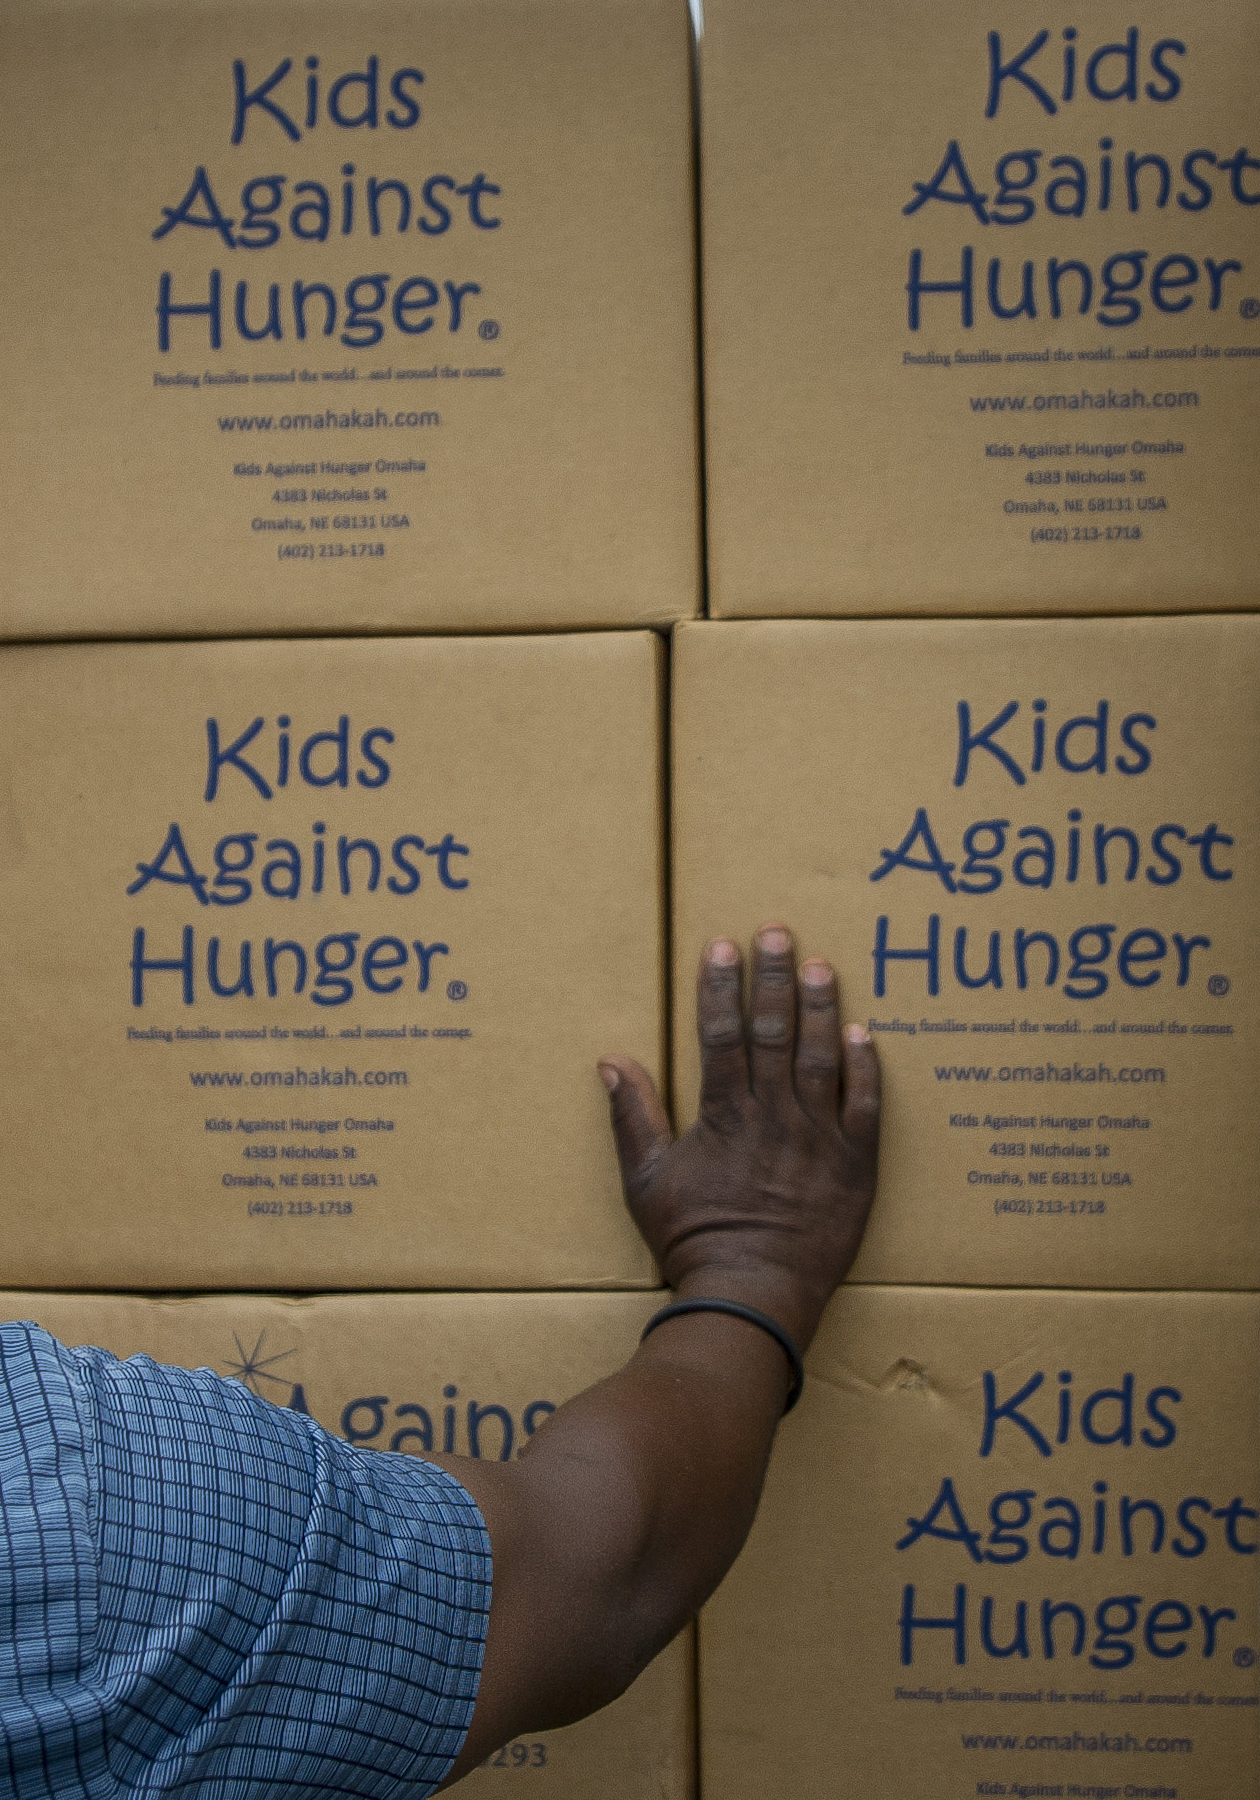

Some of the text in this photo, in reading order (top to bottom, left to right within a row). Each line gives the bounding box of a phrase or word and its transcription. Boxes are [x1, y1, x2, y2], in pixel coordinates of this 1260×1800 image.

[985, 25, 1187, 118] Kids
[231, 55, 425, 146] Kids
[902, 137, 1260, 226] Against
[151, 163, 501, 250] Against
[1053, 348, 1074, 362] the
[1201, 344, 1221, 358] the
[298, 369, 318, 383] the
[440, 366, 460, 379] the
[969, 388, 1200, 412] www.omahakah.com
[218, 408, 440, 432] www.omahakah.com
[985, 440, 1184, 459] Kids Against Hunger Omaha
[233, 459, 426, 477] Kids Against Hunger Omaha
[1025, 469, 1145, 485] 4383 Nicholas St
[272, 487, 387, 503] 4383 Nicholas St
[1003, 496, 1167, 514] Omaha, NE 68131 USA
[251, 514, 410, 532] Omaha, NE 68131 USA
[1031, 526, 1142, 543] (402) 213-1718
[278, 543, 385, 561] (402) 213-1718
[953, 698, 1157, 788] Kids
[204, 713, 396, 803] Kids
[869, 806, 1234, 895] Against
[126, 821, 470, 906] Against
[270, 1026, 290, 1040] the
[410, 1025, 429, 1038] the
[1019, 1019, 1040, 1034] the
[1168, 1020, 1188, 1035] the
[190, 1067, 408, 1087] www.omahakah.com
[934, 1063, 1167, 1084] www.omahakah.com
[205, 1118, 394, 1133] Kids Against Hunger Omaha
[949, 1113, 1151, 1131] Kids Against Hunger Omaha
[242, 1145, 356, 1159] 4383 Nicholas St
[989, 1143, 1110, 1157] 4383 Nicholas St
[222, 1173, 378, 1188] Omaha, NE 68131 USA
[967, 1171, 1133, 1186] Omaha, NE 68131 USA
[248, 1201, 353, 1216] (402) 213-1718
[994, 1200, 1106, 1215] (402) 213-1718
[978, 1370, 1183, 1458] Kids
[895, 1477, 1259, 1565] Against
[961, 1732, 1193, 1753] www.omahakah.com
[976, 1782, 1177, 1800] Kids Against Hunger Omaha
